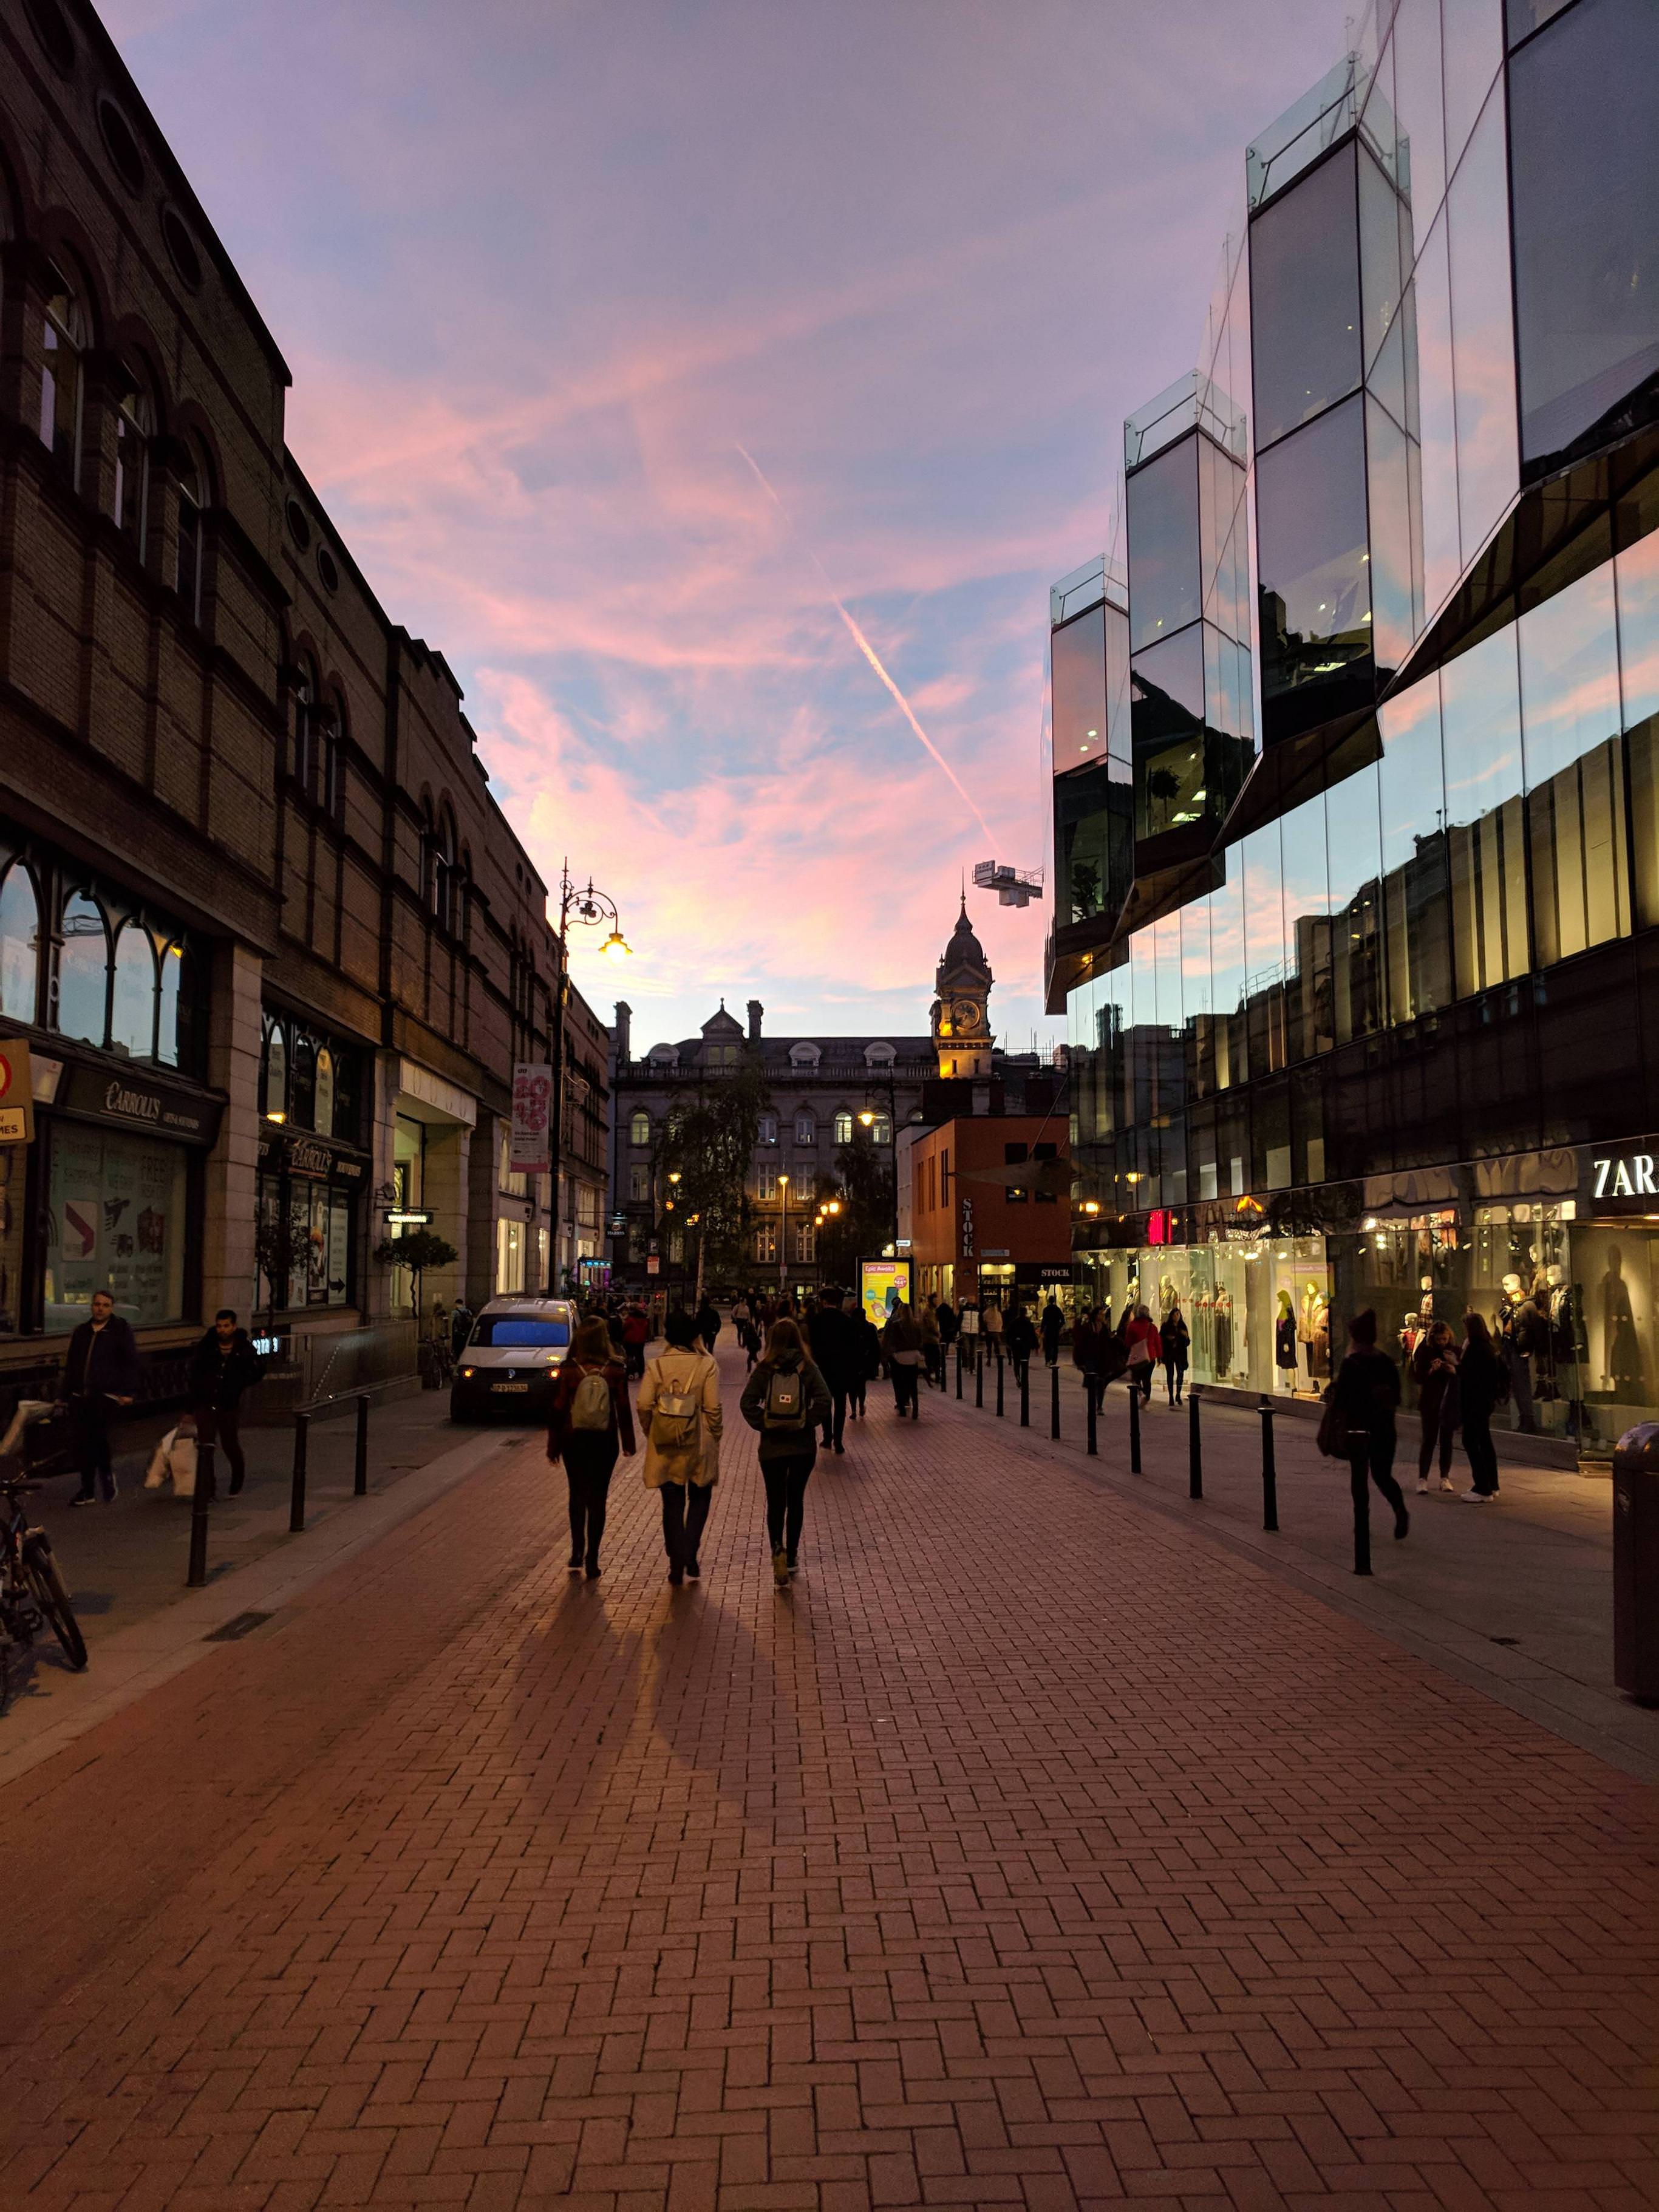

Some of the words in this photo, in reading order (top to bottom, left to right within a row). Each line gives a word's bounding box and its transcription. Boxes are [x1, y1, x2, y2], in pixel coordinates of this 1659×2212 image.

[1593, 1155, 1659, 1198] ZAR
[962, 1198, 974, 1257] STOCK
[1040, 1268, 1071, 1278] STOCK
